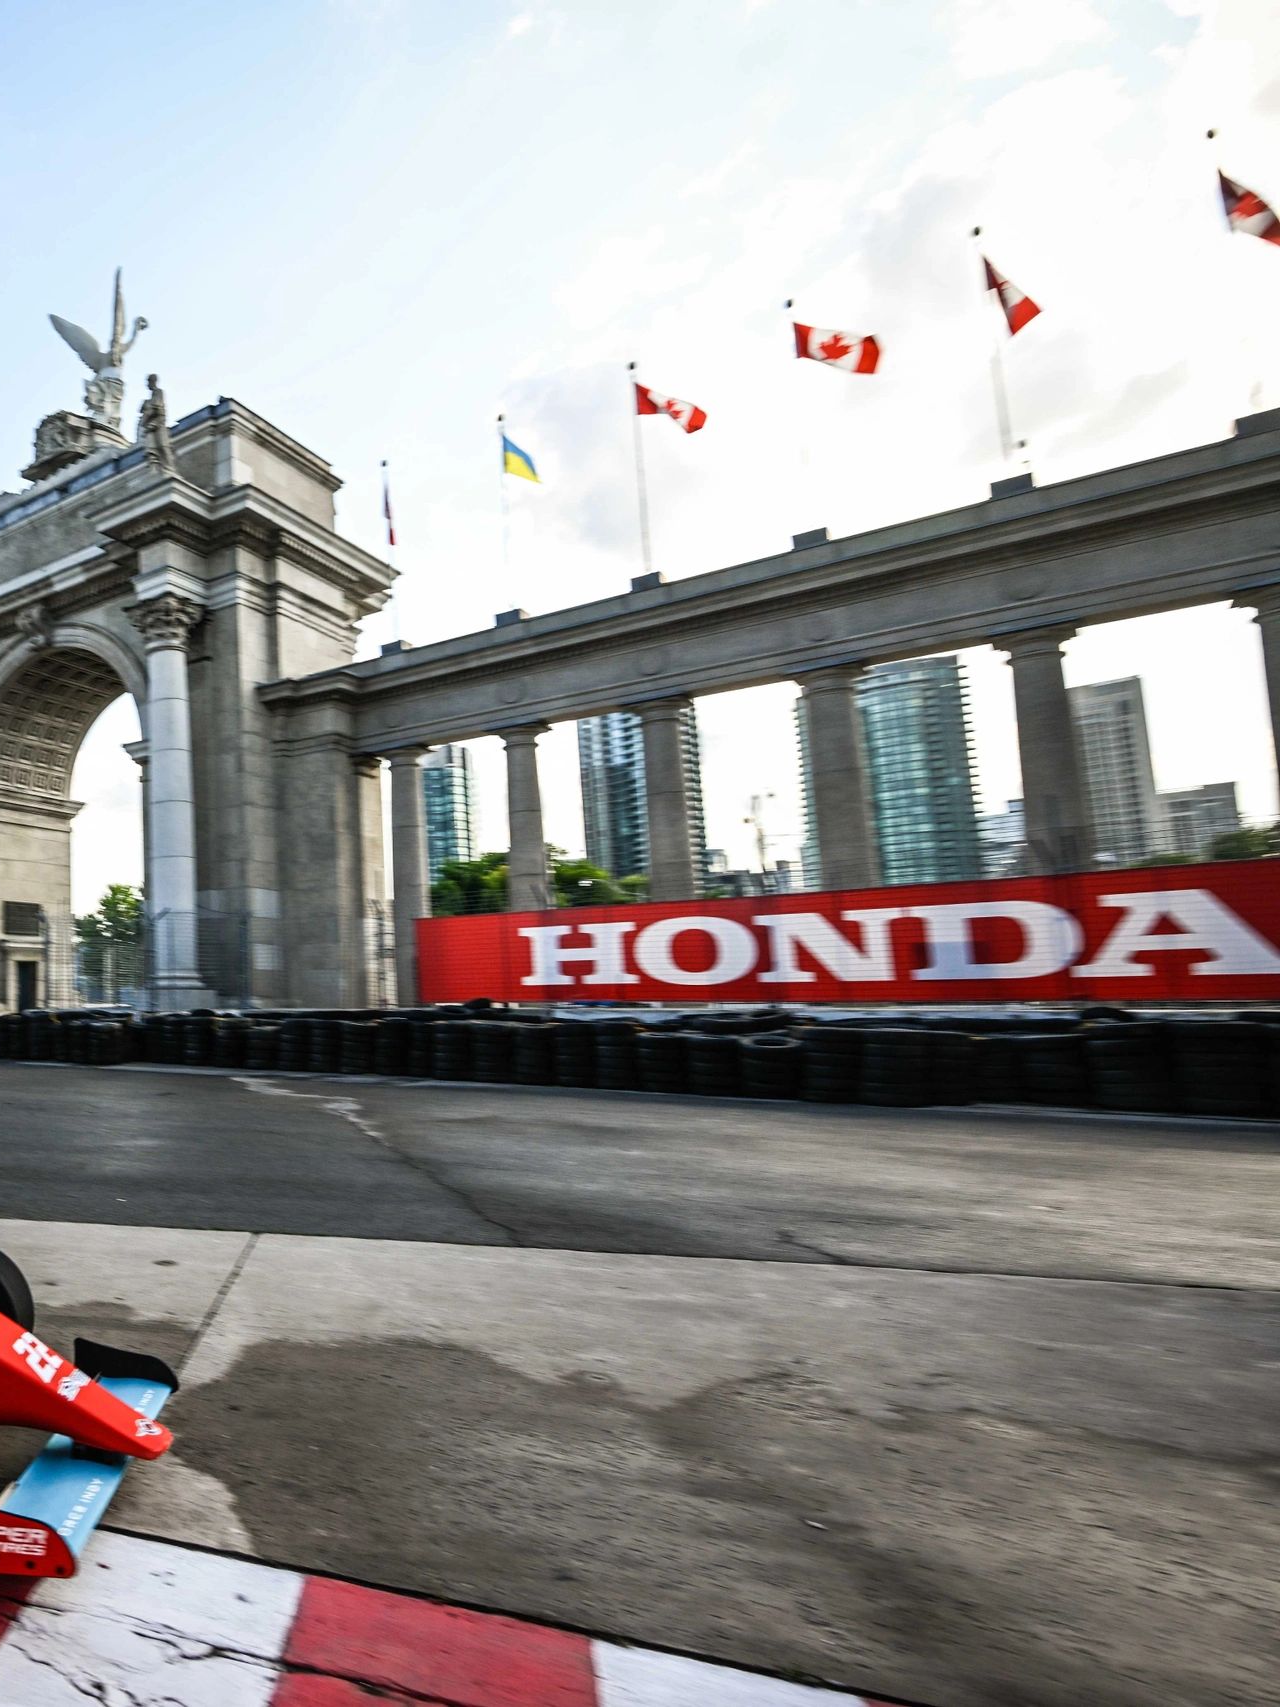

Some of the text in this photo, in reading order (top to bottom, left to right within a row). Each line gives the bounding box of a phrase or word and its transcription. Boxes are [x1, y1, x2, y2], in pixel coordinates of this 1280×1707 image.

[518, 888, 1280, 987] HONDA
[12, 1331, 64, 1384] 22
[81, 1478, 105, 1505] INDY
